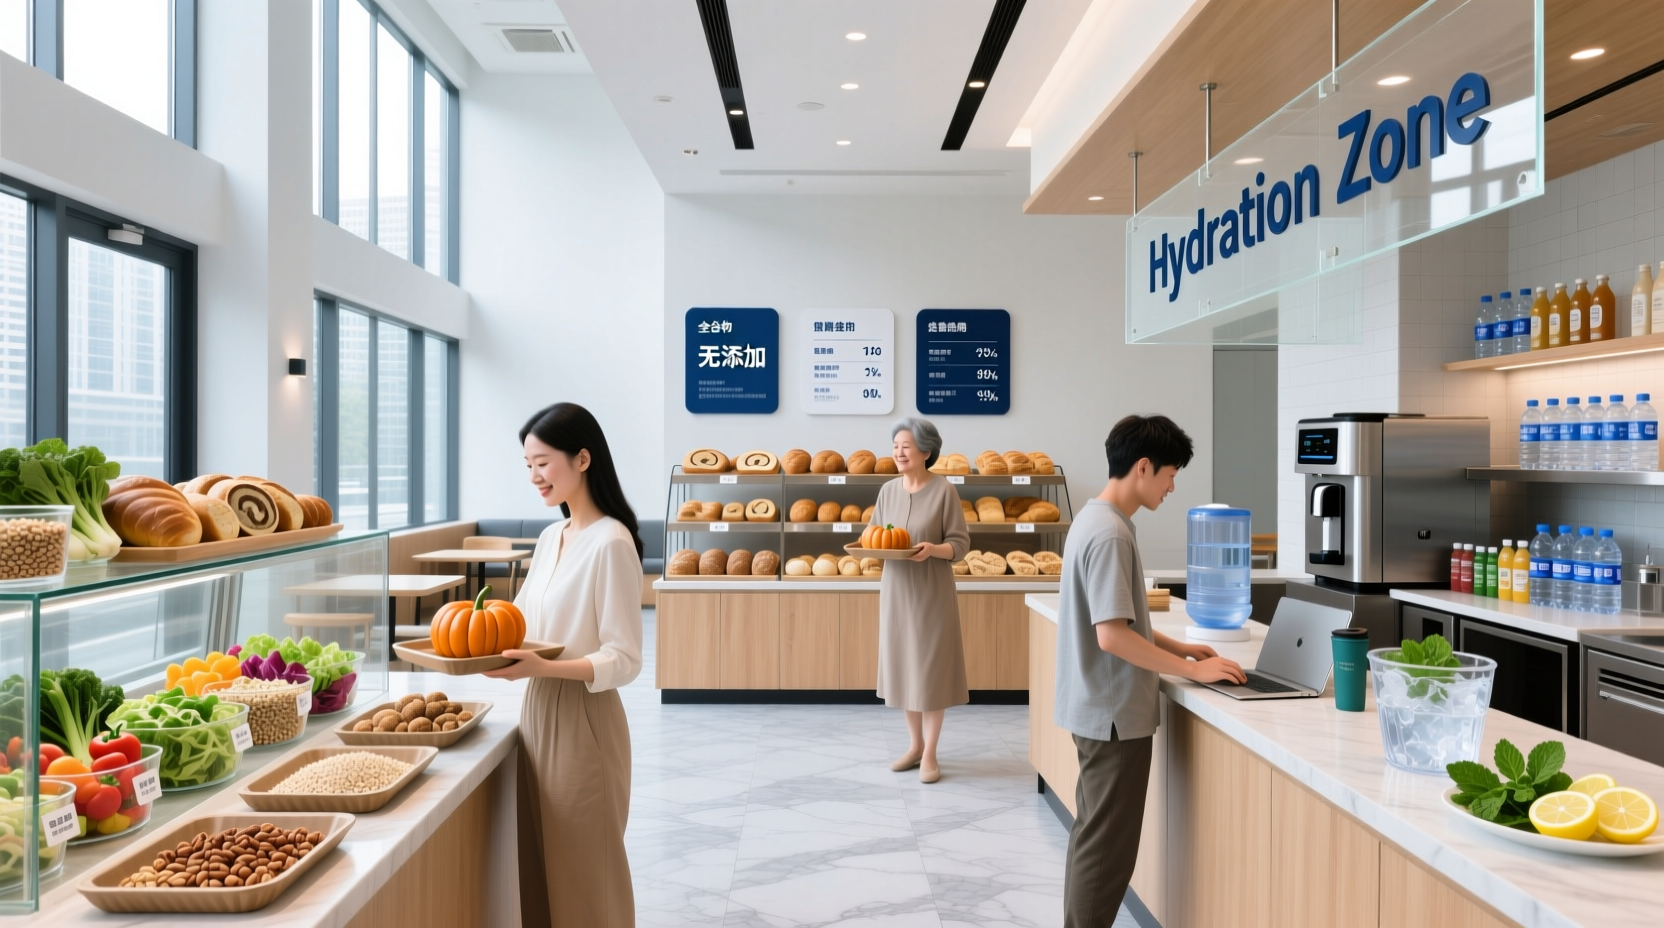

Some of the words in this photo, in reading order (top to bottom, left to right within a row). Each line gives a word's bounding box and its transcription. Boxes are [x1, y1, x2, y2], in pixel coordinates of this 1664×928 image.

[1149, 164, 1320, 303] Hydration
[1336, 72, 1491, 204] Zone
[698, 343, 766, 368] 无添加
